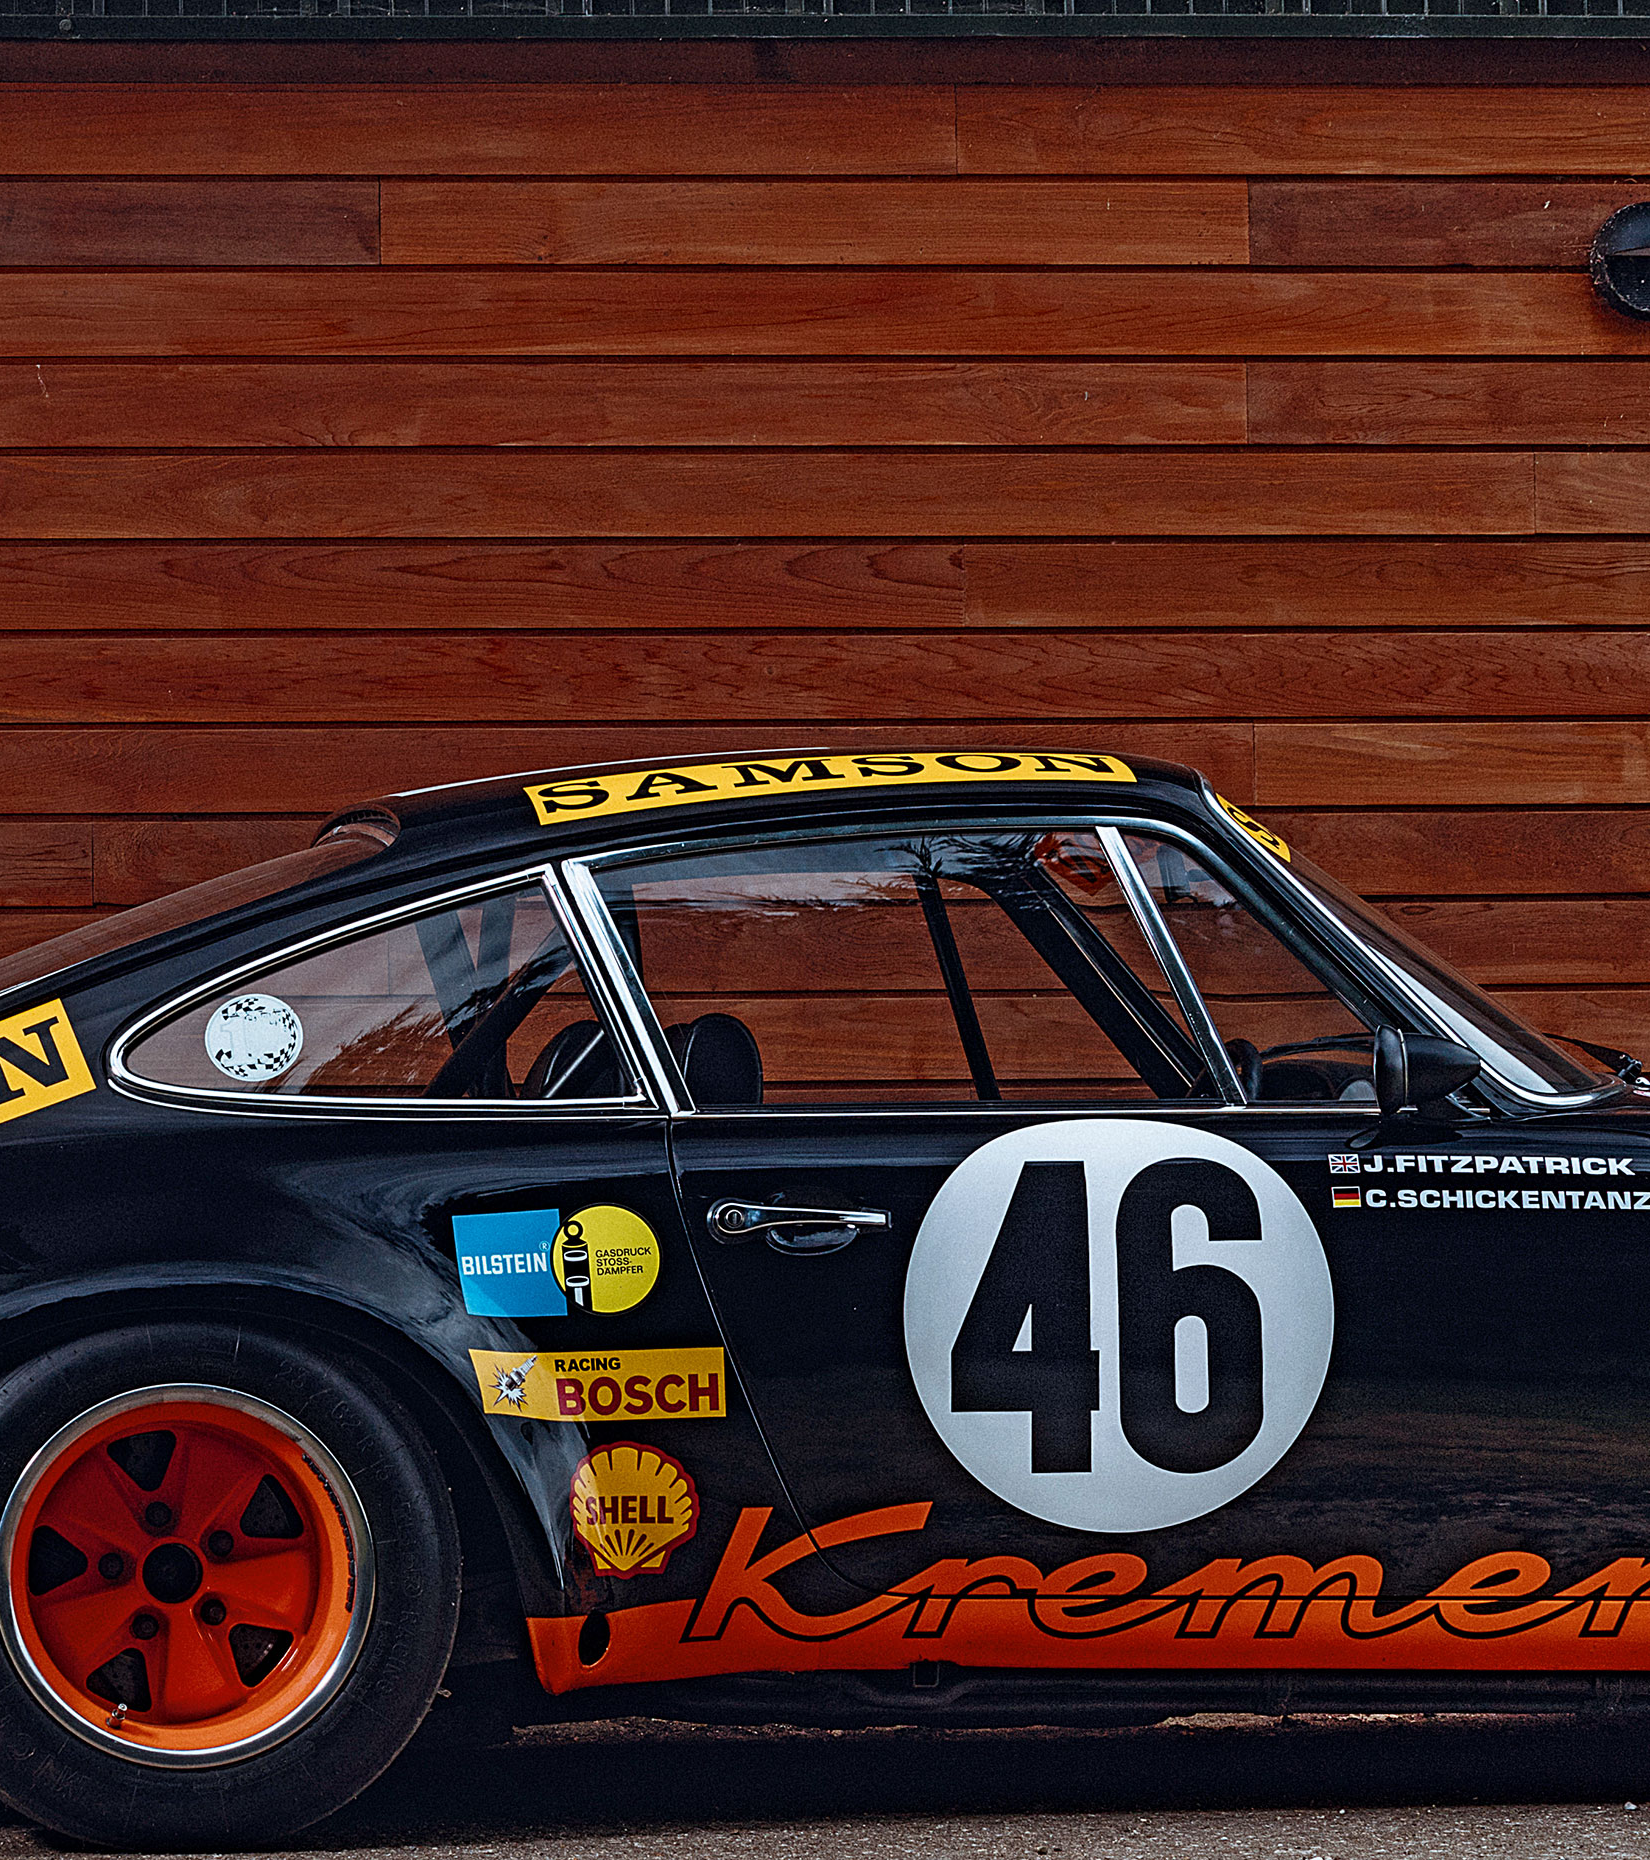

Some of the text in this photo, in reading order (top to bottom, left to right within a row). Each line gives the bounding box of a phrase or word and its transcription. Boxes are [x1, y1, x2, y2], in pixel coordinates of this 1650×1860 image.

[546, 753, 1116, 814] SAMSON
[1363, 1154, 1636, 1177] J.FITZPATRICK
[1365, 1188, 1650, 1210] C.SCHICKENTANZ
[461, 1252, 548, 1276] BILSTEIN
[595, 1246, 652, 1258] GASDRUCK
[950, 1156, 1264, 1475] 46
[554, 1357, 621, 1373] RACING
[555, 1373, 720, 1416] BOSCH
[585, 1495, 674, 1525] SHELL
[679, 1500, 1650, 1645] Kremer
